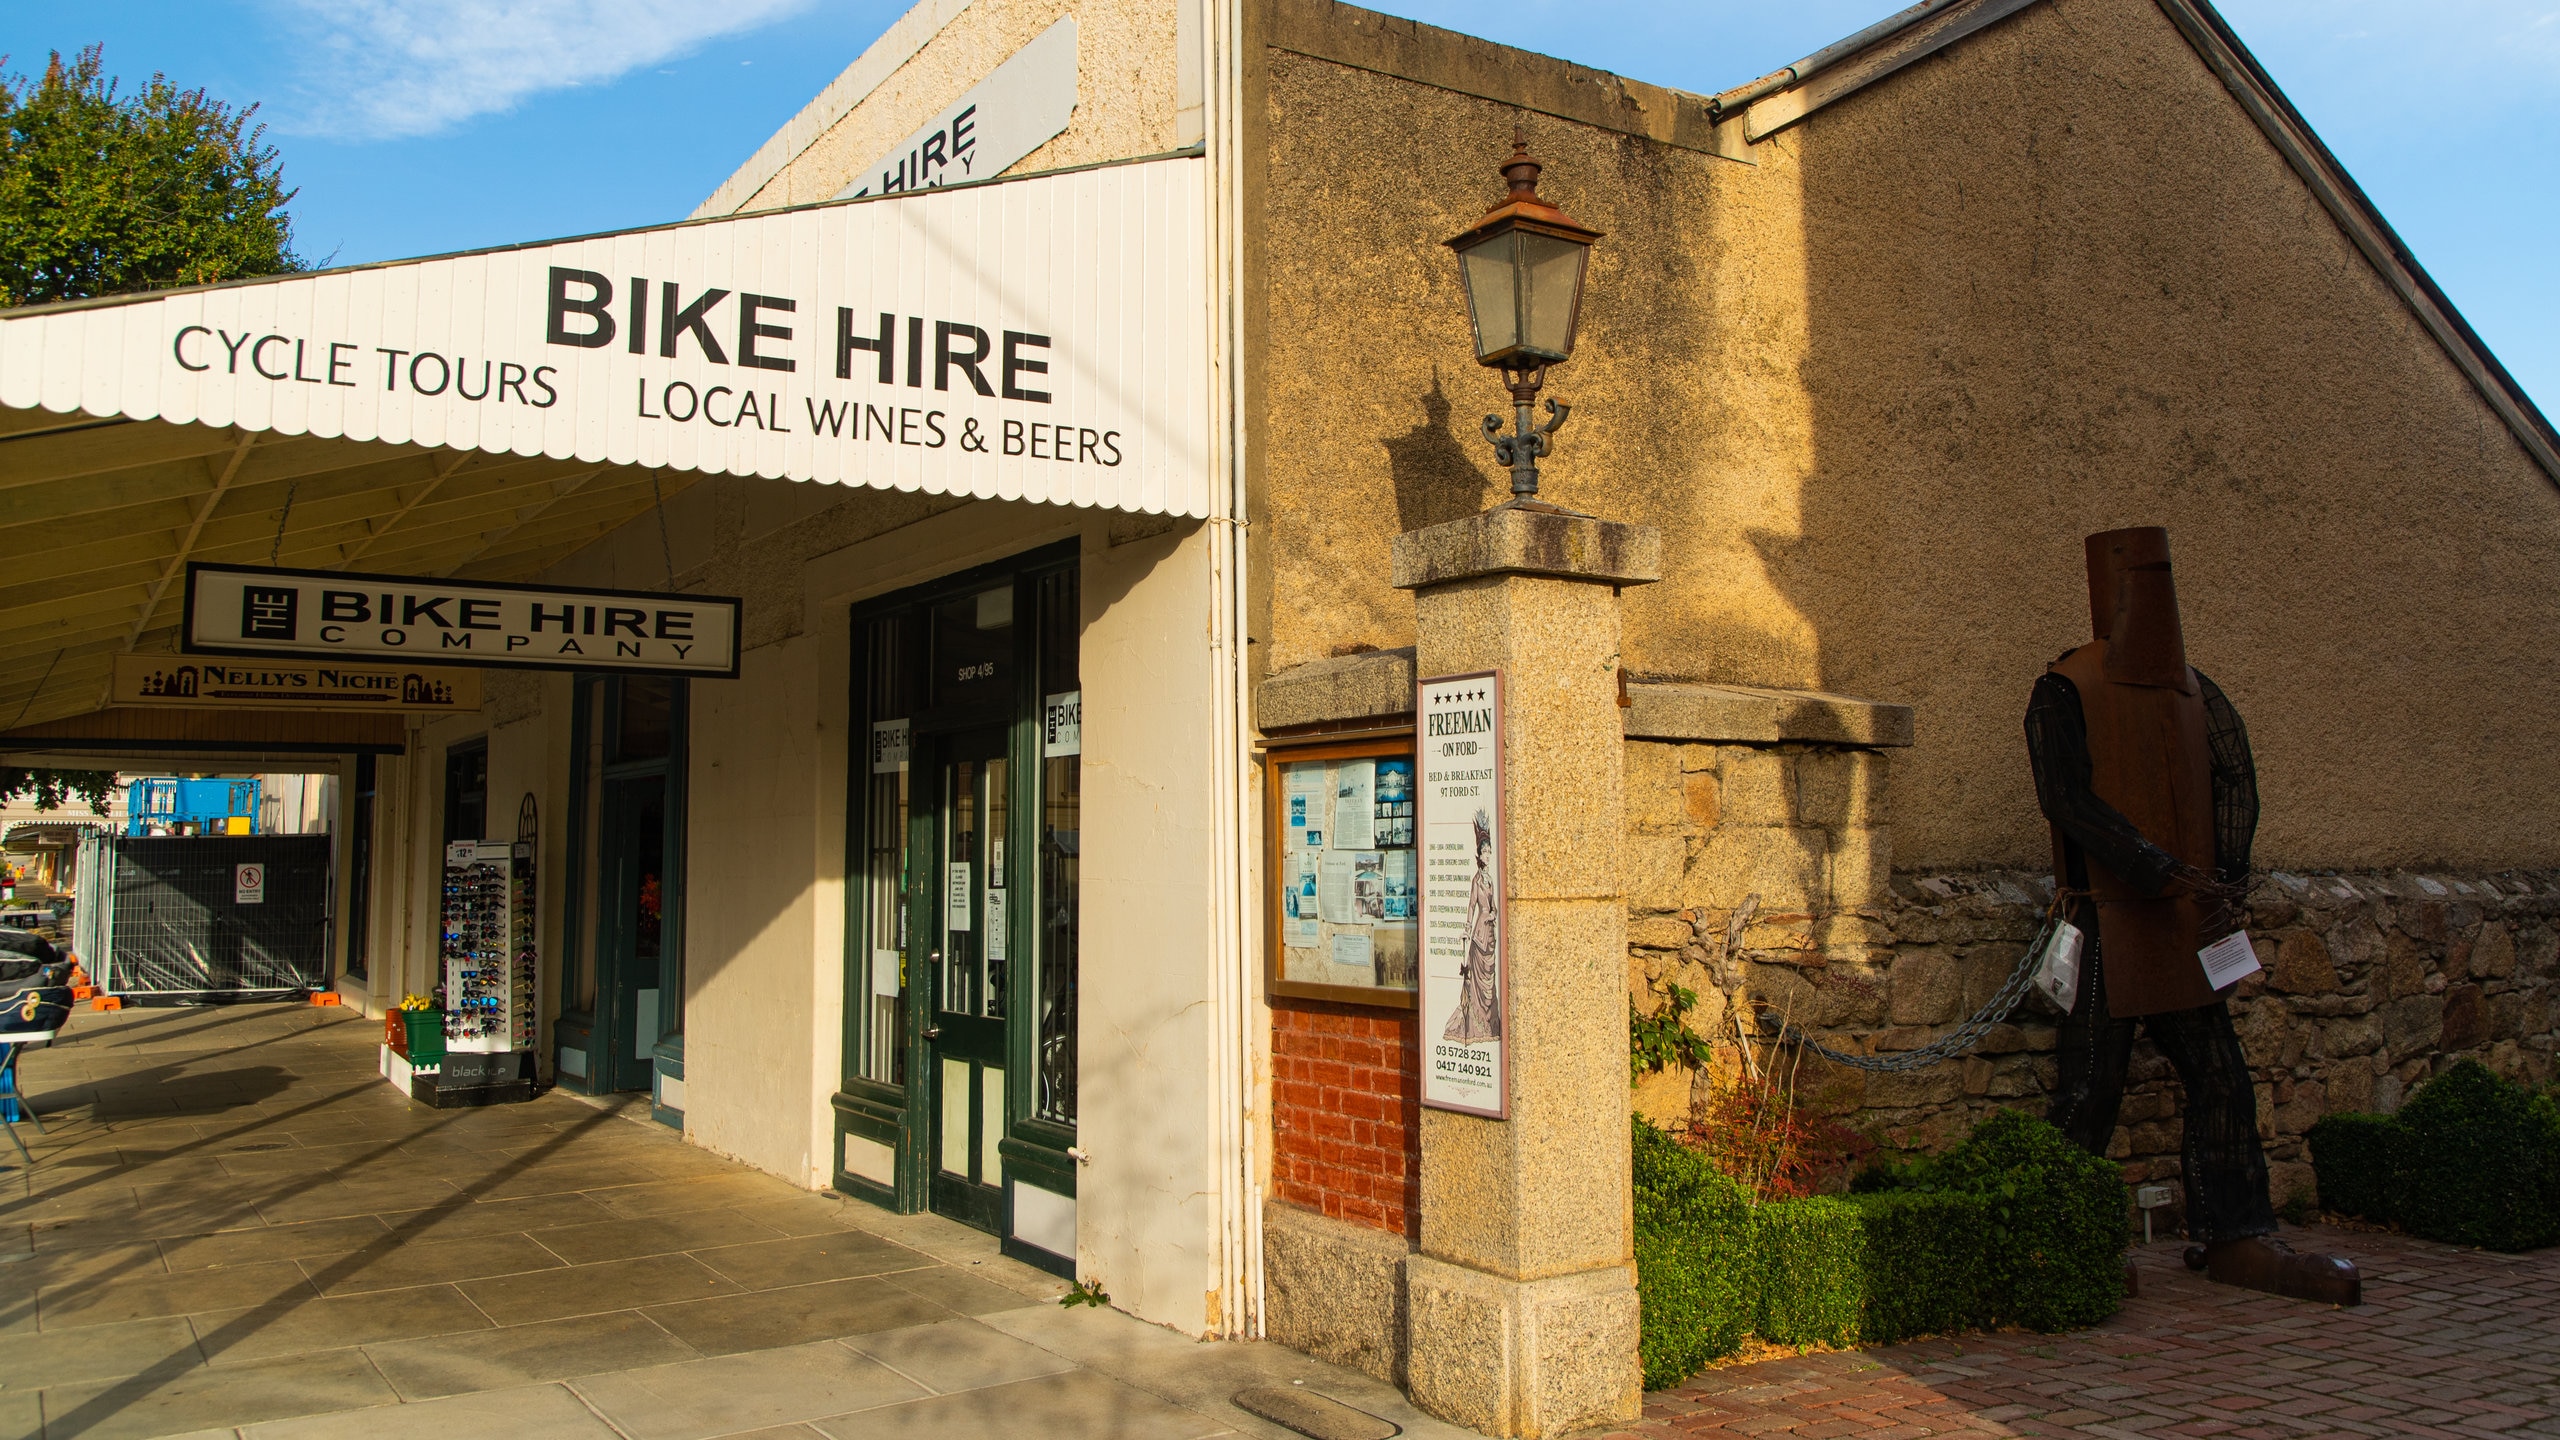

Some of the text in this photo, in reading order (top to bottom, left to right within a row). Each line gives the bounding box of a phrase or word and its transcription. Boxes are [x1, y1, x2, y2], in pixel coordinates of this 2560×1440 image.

[883, 103, 976, 194] HIRE
[547, 265, 1052, 404] BIKE HIRE
[173, 325, 558, 409] CYCLE TOURS
[638, 378, 1122, 467] LOCAL WINES & BEERS
[252, 593, 289, 632] THE
[321, 590, 694, 641] BIKE HIRE
[319, 625, 693, 660] COMPANY
[203, 665, 400, 690] NELLY'S NICHE
[958, 661, 994, 681] SHOP 4/95
[1428, 708, 1492, 737] FREEMAN
[882, 728, 900, 748] BIKE
[1442, 741, 1478, 757] ON FORD
[1428, 768, 1493, 782] BED & BREAKFAST
[1440, 786, 1448, 798] 97
[1449, 785, 1469, 797] FORD
[1435, 1045, 1492, 1062] 03 5728 2371
[452, 1065, 486, 1077] black
[1436, 1060, 1492, 1077] 0417 140 921
